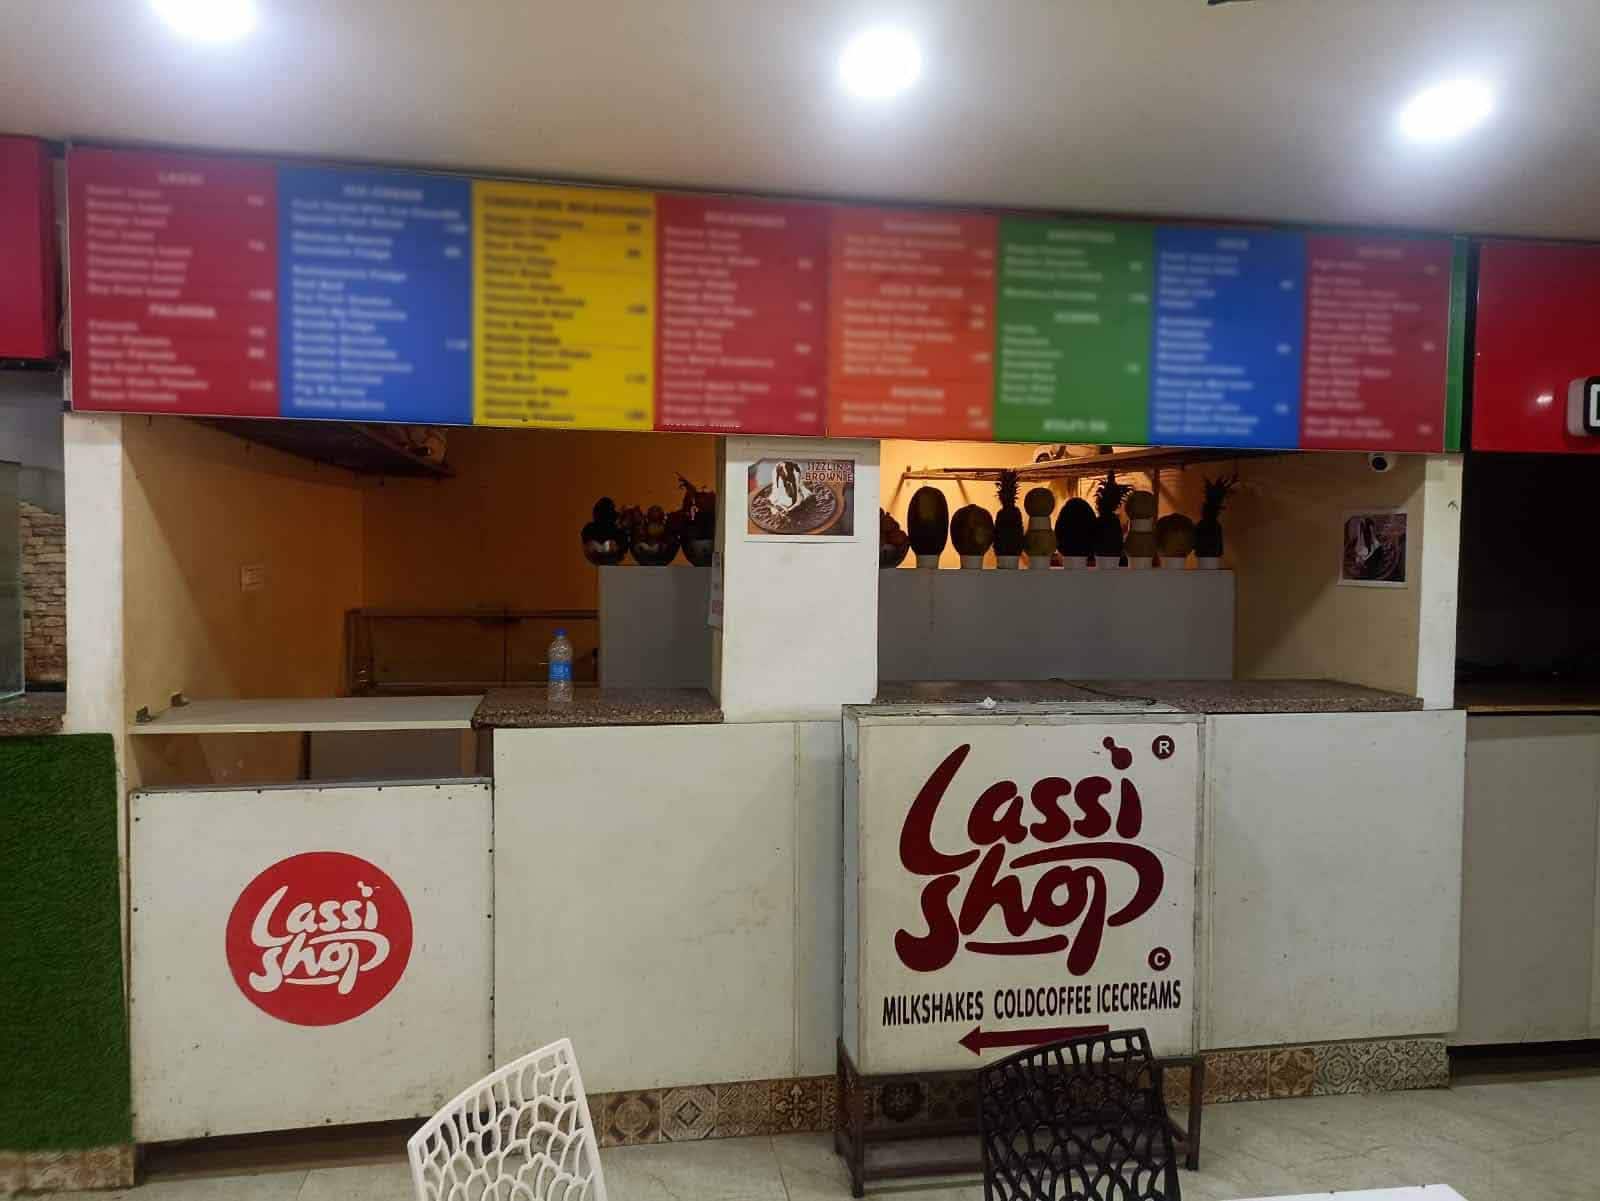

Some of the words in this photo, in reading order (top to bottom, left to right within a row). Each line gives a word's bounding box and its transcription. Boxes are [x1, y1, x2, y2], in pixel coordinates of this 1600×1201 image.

[900, 736, 1143, 876] Lassi
[251, 880, 379, 948] Lassi
[882, 991, 984, 1026] MILKSHAKES
[994, 984, 1092, 1020] COLDCOFFEE
[1096, 979, 1181, 1013] ICECREAMS
